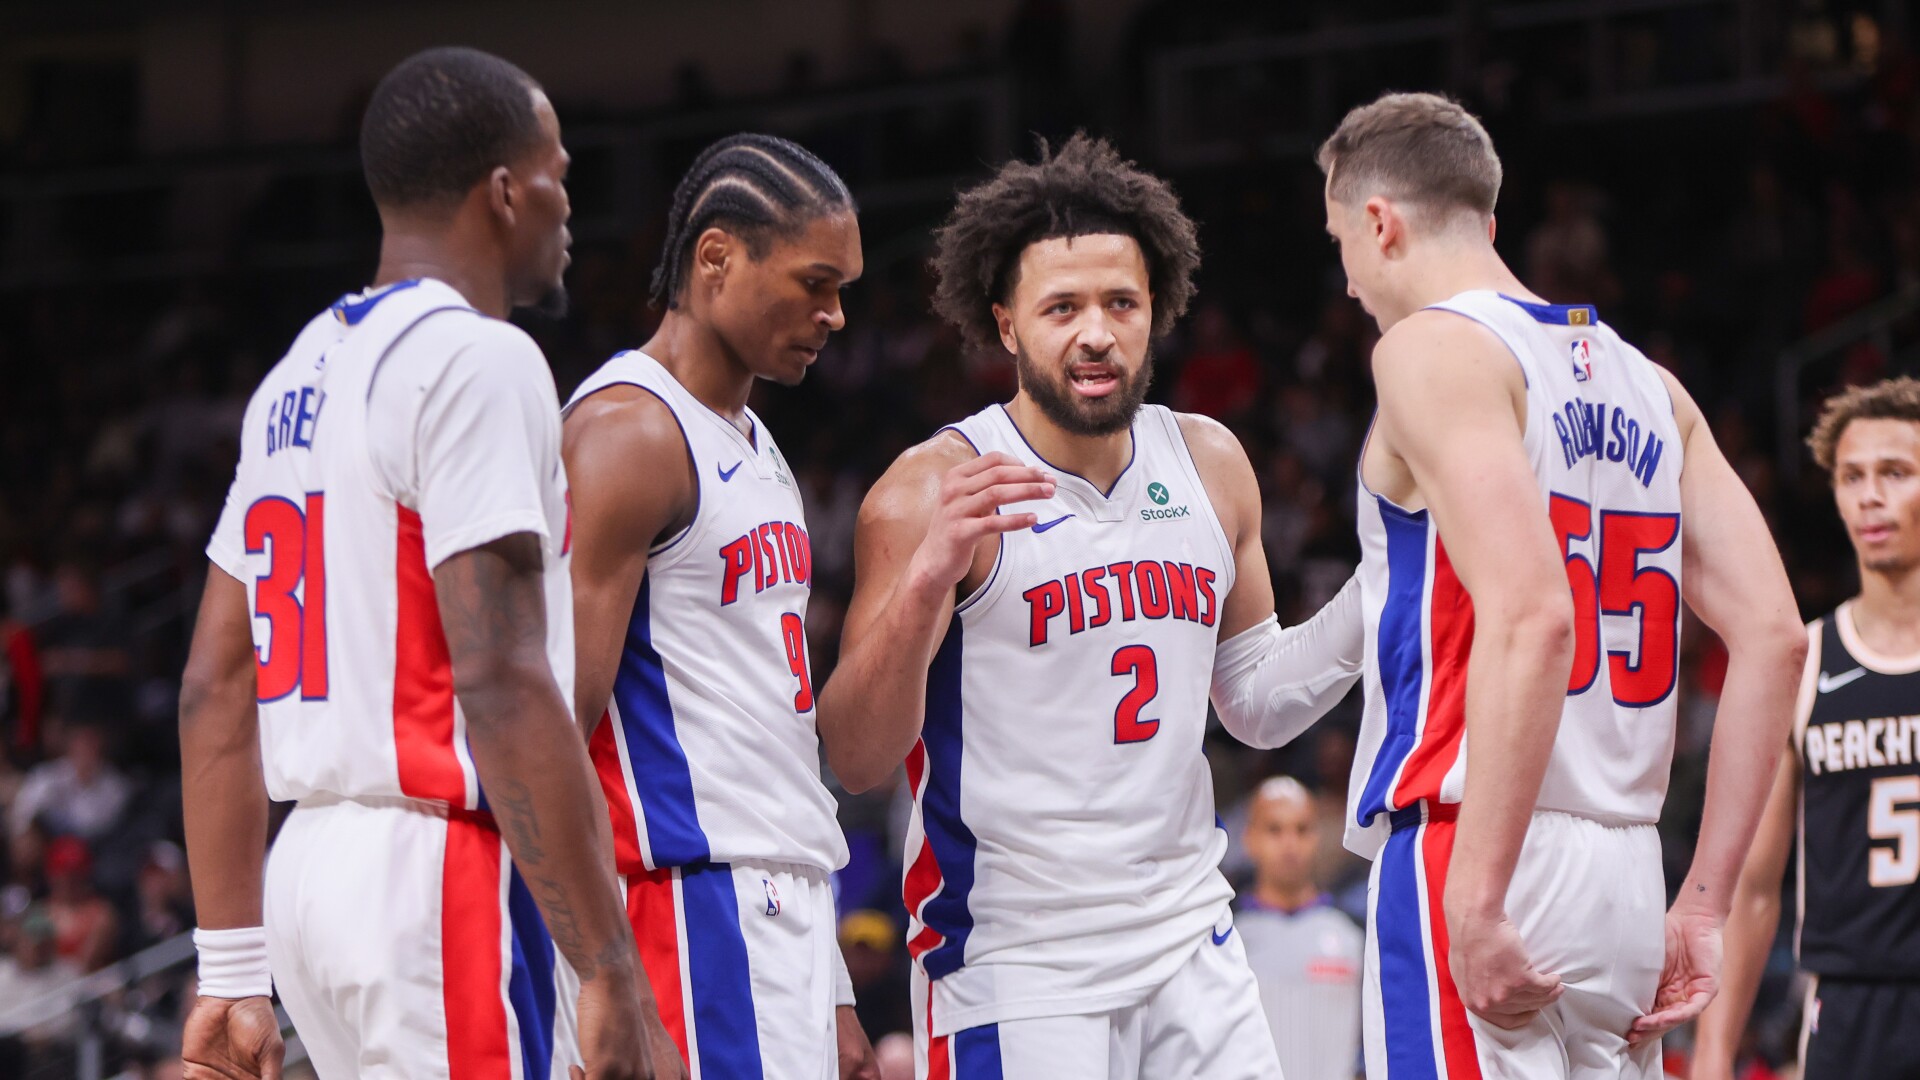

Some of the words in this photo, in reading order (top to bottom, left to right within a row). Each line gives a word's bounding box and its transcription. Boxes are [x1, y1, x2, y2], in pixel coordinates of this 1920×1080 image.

[267, 386, 327, 457] GRE
[1552, 396, 1664, 489] ROBNSON
[1140, 505, 1190, 521] StockX
[244, 490, 328, 704] 31
[719, 520, 812, 607] PISTON
[1023, 560, 1216, 648] PISTONS
[1549, 491, 1681, 709] 55
[781, 611, 813, 713] 9
[1111, 644, 1160, 745] 2
[1867, 775, 1920, 888] 5
